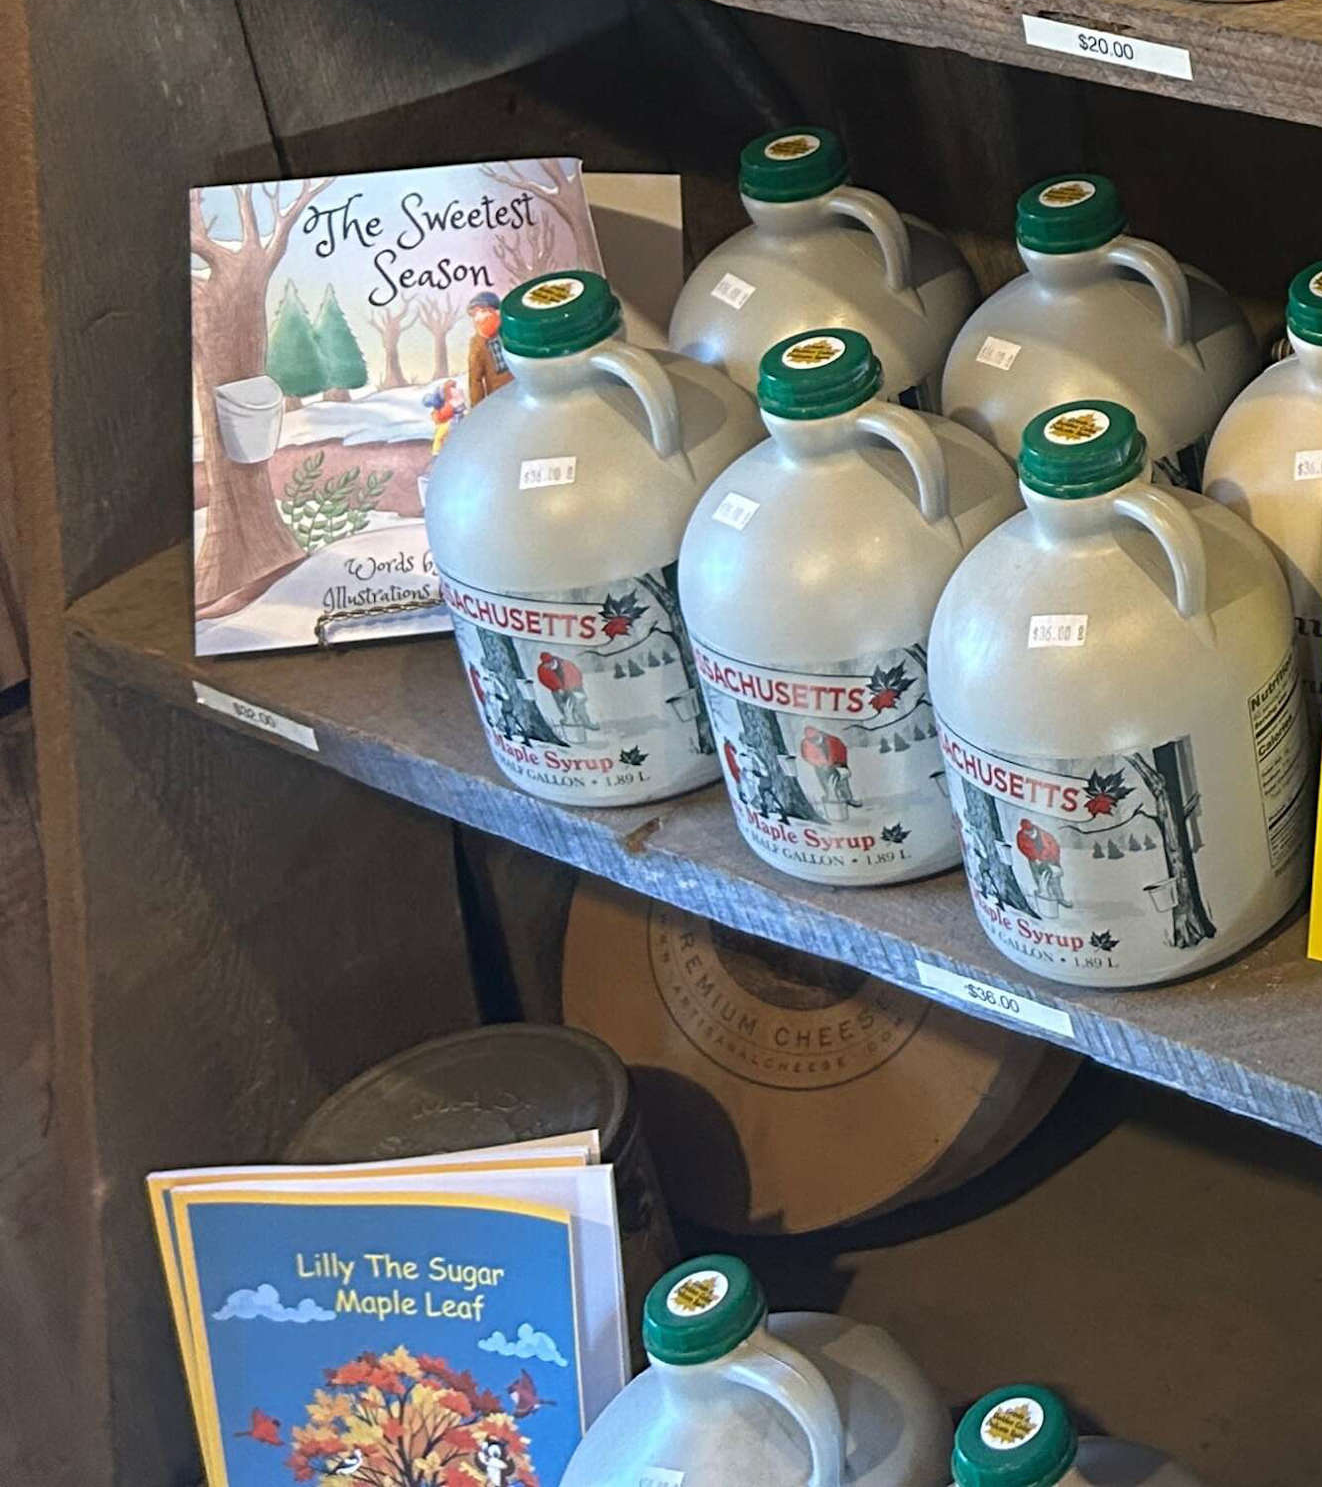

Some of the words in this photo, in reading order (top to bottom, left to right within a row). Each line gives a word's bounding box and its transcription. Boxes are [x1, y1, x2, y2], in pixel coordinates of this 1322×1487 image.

[1078, 34, 1134, 61] $20.00
[303, 194, 383, 257] The
[397, 192, 537, 250] Sweetest
[368, 249, 495, 306] Season
[345, 552, 414, 580] Words
[323, 586, 430, 608] Illustrations
[679, 932, 756, 1035] REMIUM
[775, 1013, 875, 1048] CHEES
[968, 984, 1020, 1013] $36.00
[297, 1253, 354, 1285] Lilly
[364, 1254, 419, 1280] The
[429, 1257, 504, 1291] Sugar
[336, 1290, 417, 1321] Maple
[425, 1292, 485, 1322] Leaf
